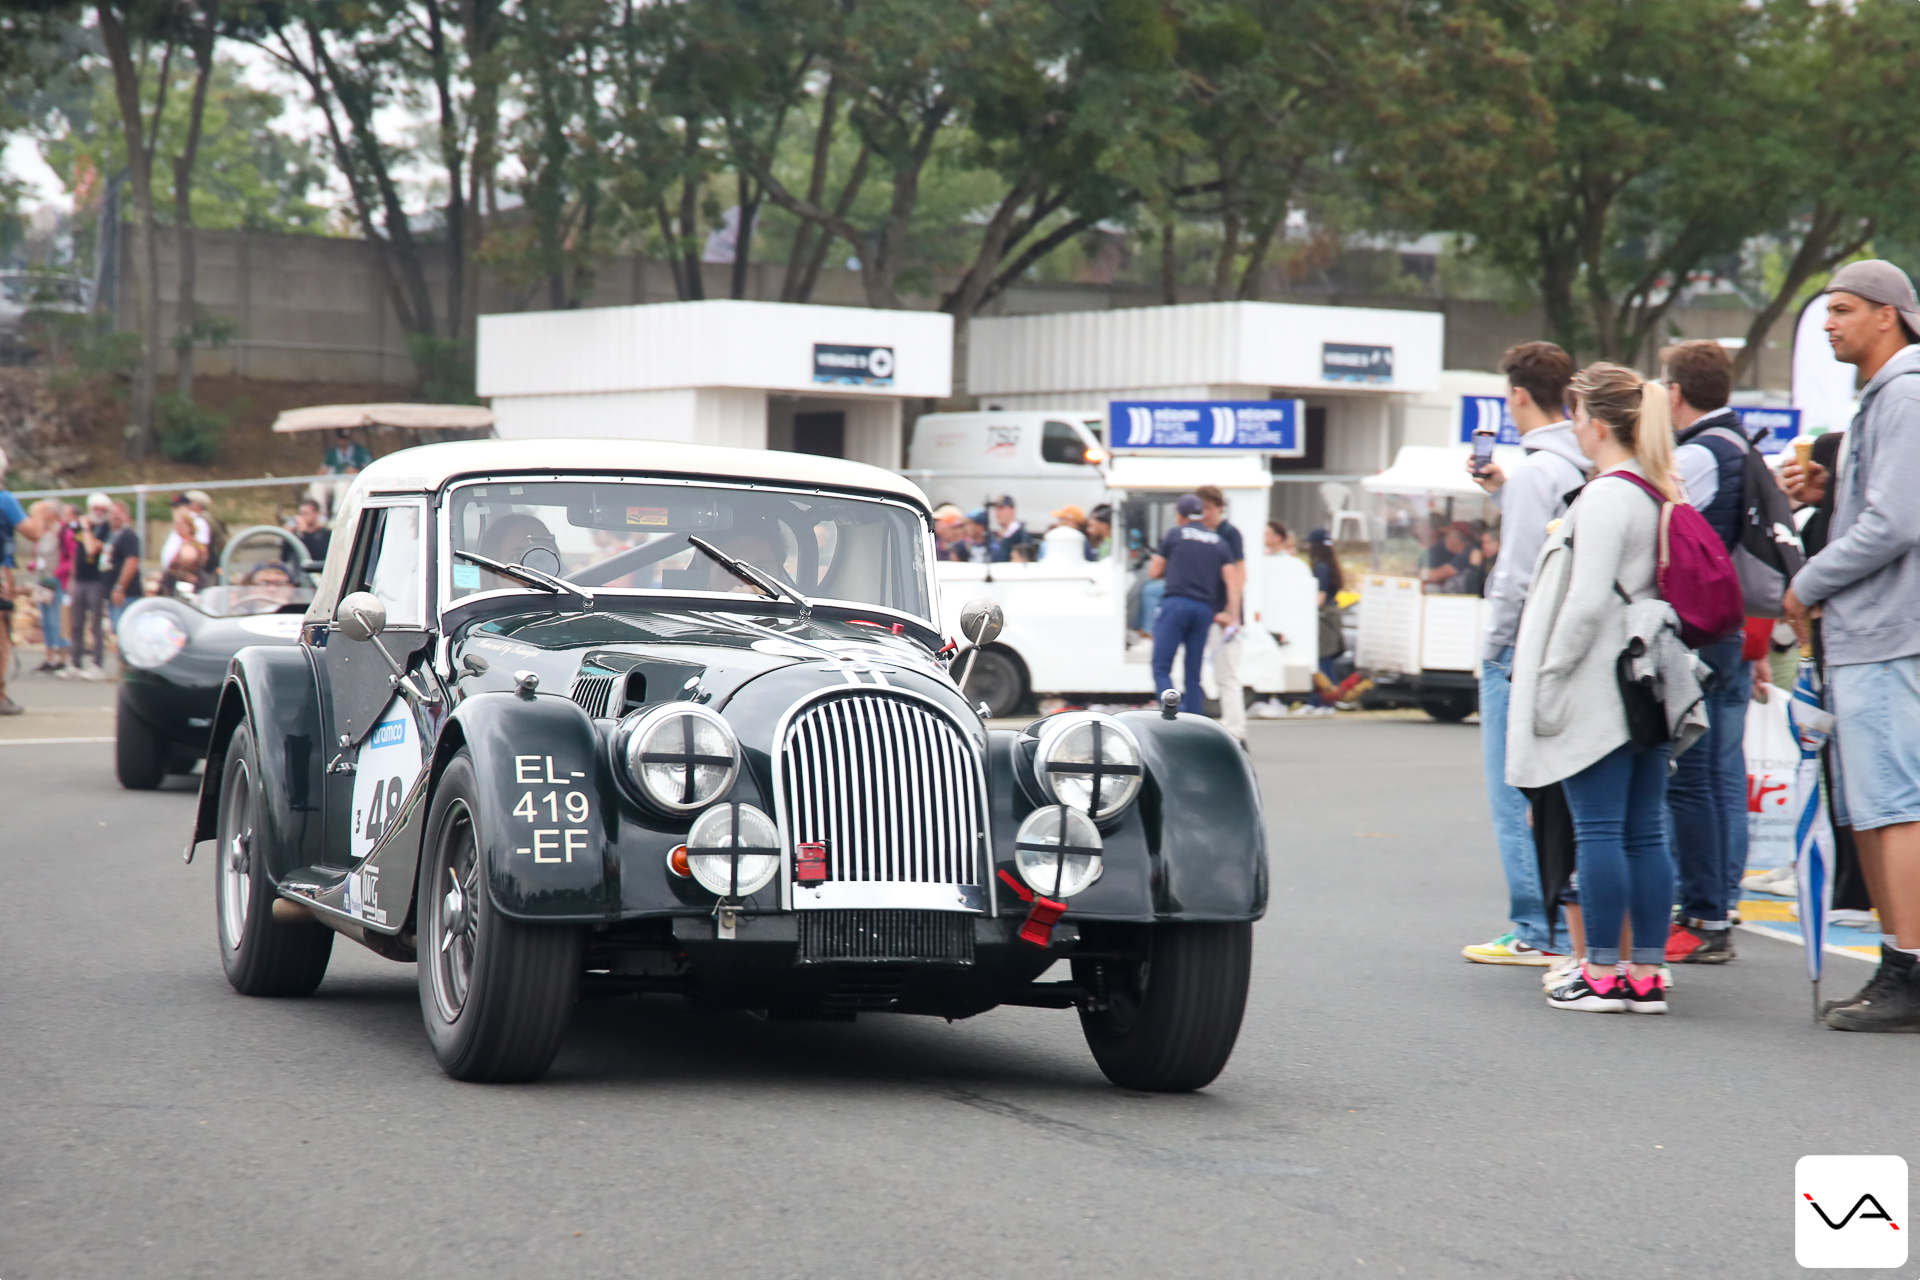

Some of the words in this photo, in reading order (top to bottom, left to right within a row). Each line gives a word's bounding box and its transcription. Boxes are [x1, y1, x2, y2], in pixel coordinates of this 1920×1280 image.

[986, 425, 1021, 444] TSG
[372, 722, 403, 745] aramco
[515, 755, 586, 784] EL-
[365, 776, 403, 846] 48
[512, 790, 590, 823] 419
[516, 829, 589, 863] -EF
